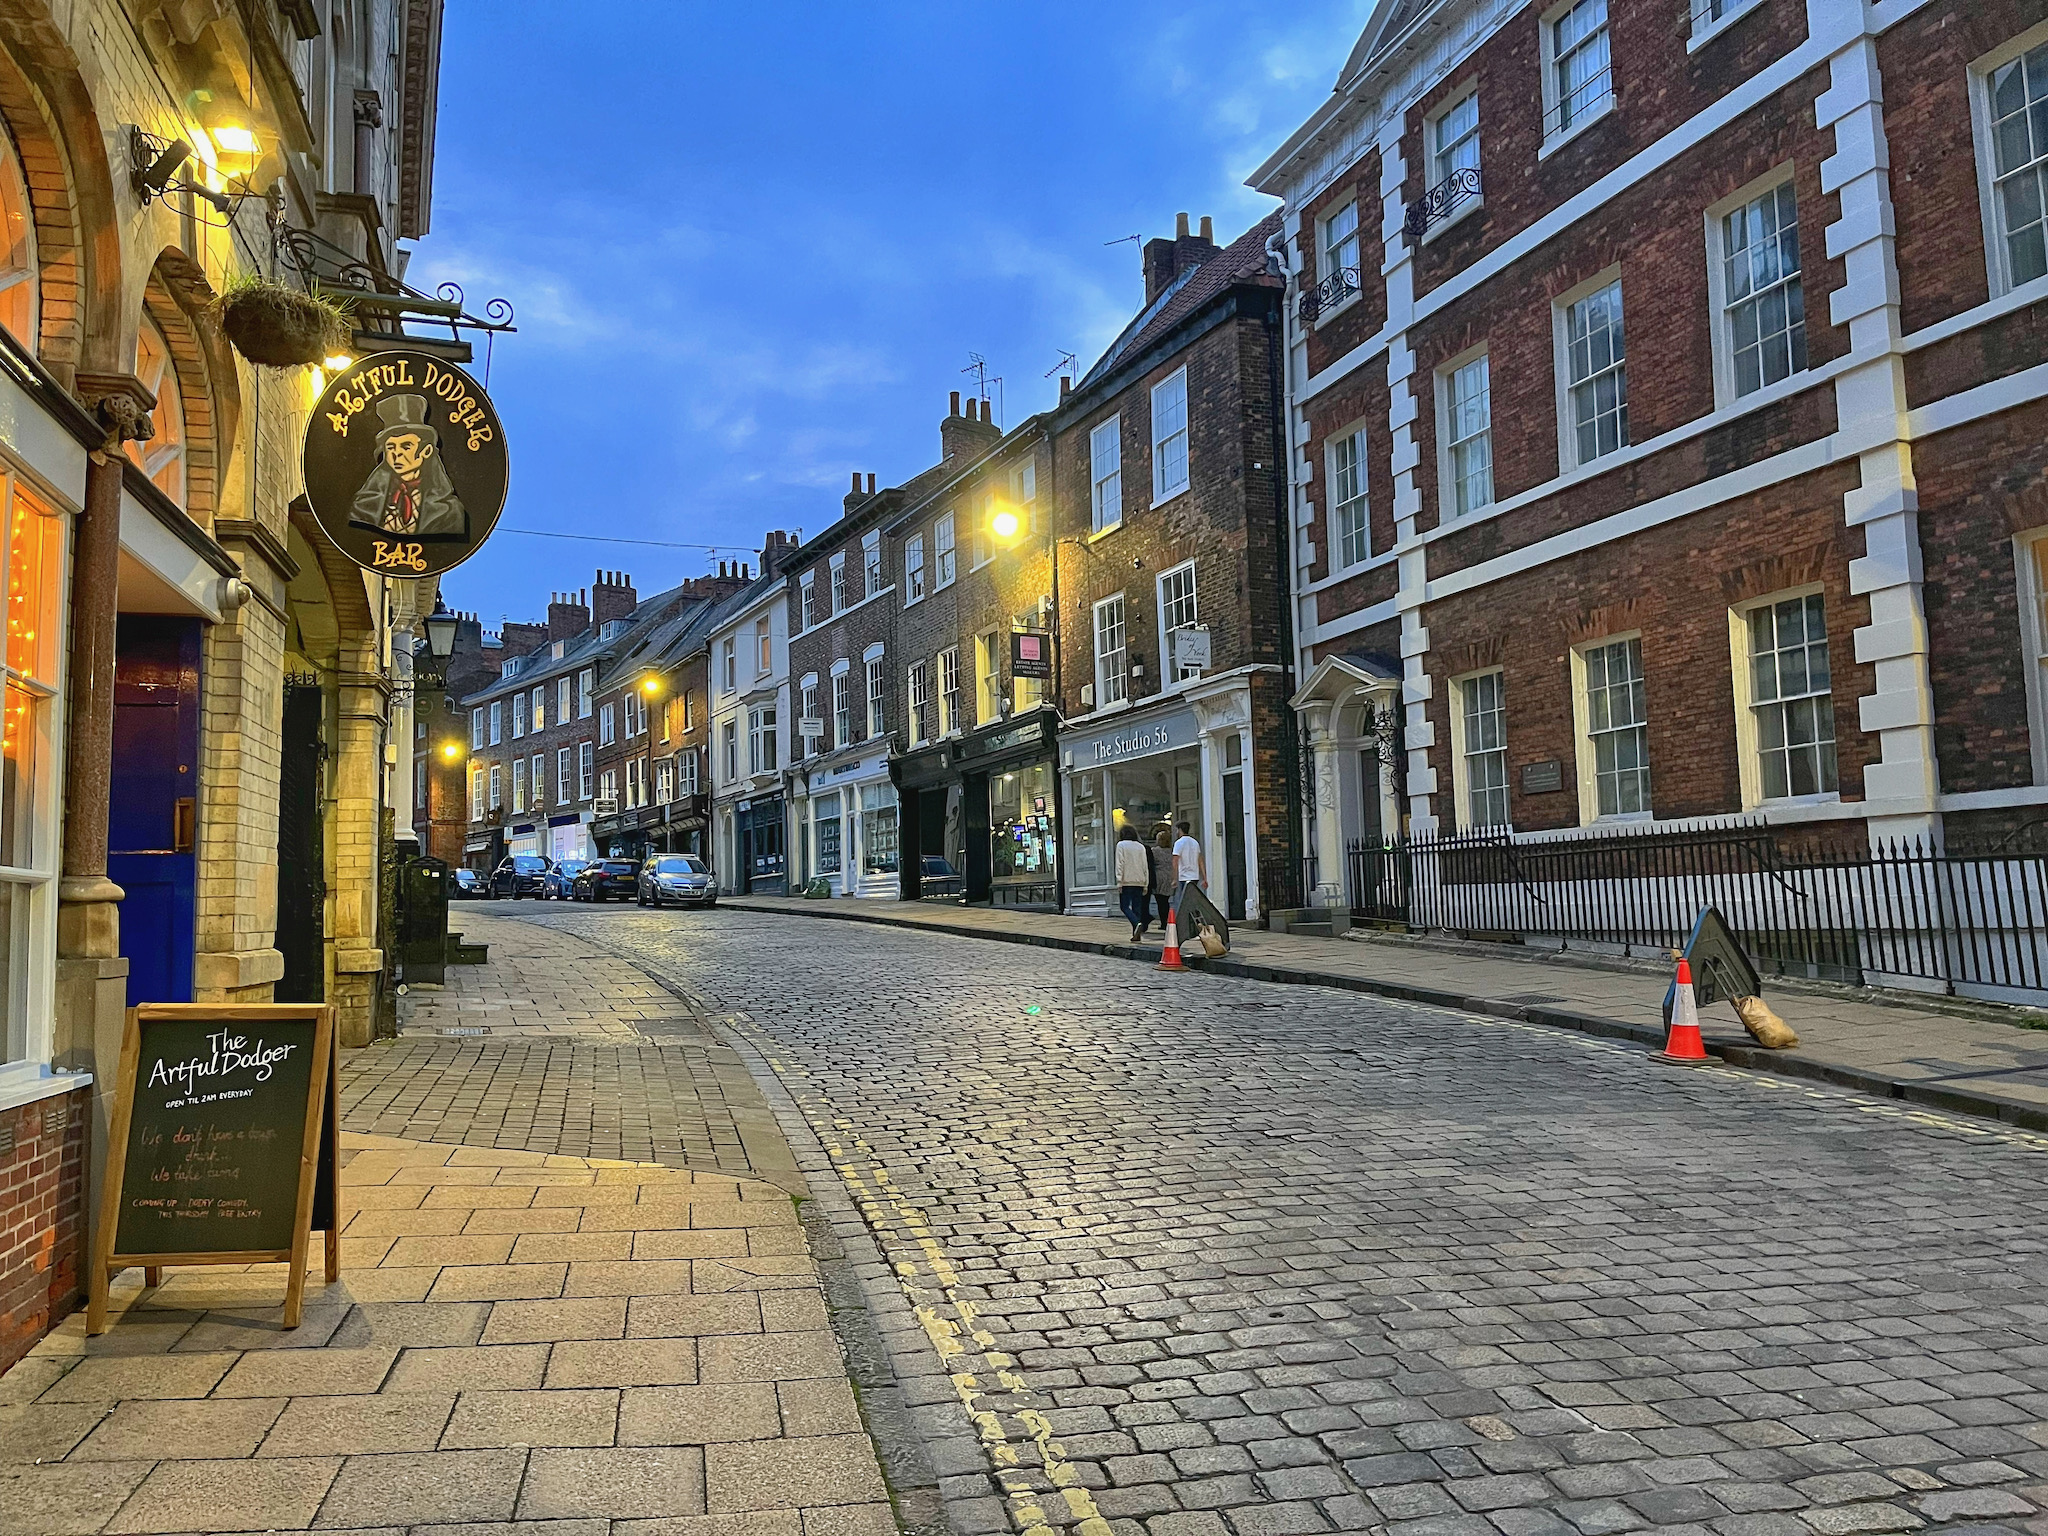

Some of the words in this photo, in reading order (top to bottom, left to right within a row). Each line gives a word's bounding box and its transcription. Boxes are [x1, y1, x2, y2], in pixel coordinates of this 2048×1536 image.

[326, 360, 414, 437] ARTFUL
[422, 362, 493, 452] DODGER
[372, 541, 428, 571] BAR
[1092, 740, 1112, 760] The
[1115, 730, 1151, 755] Studio
[1154, 725, 1168, 746] 56
[206, 1027, 249, 1054] The
[147, 1051, 220, 1096] Artful
[220, 1039, 298, 1081] Dodger
[165, 1099, 185, 1109] OPEN
[187, 1097, 200, 1105] TIL
[201, 1094, 217, 1103] 2AM
[219, 1089, 254, 1101] EVERYDAY
[150, 1166, 170, 1182] We
